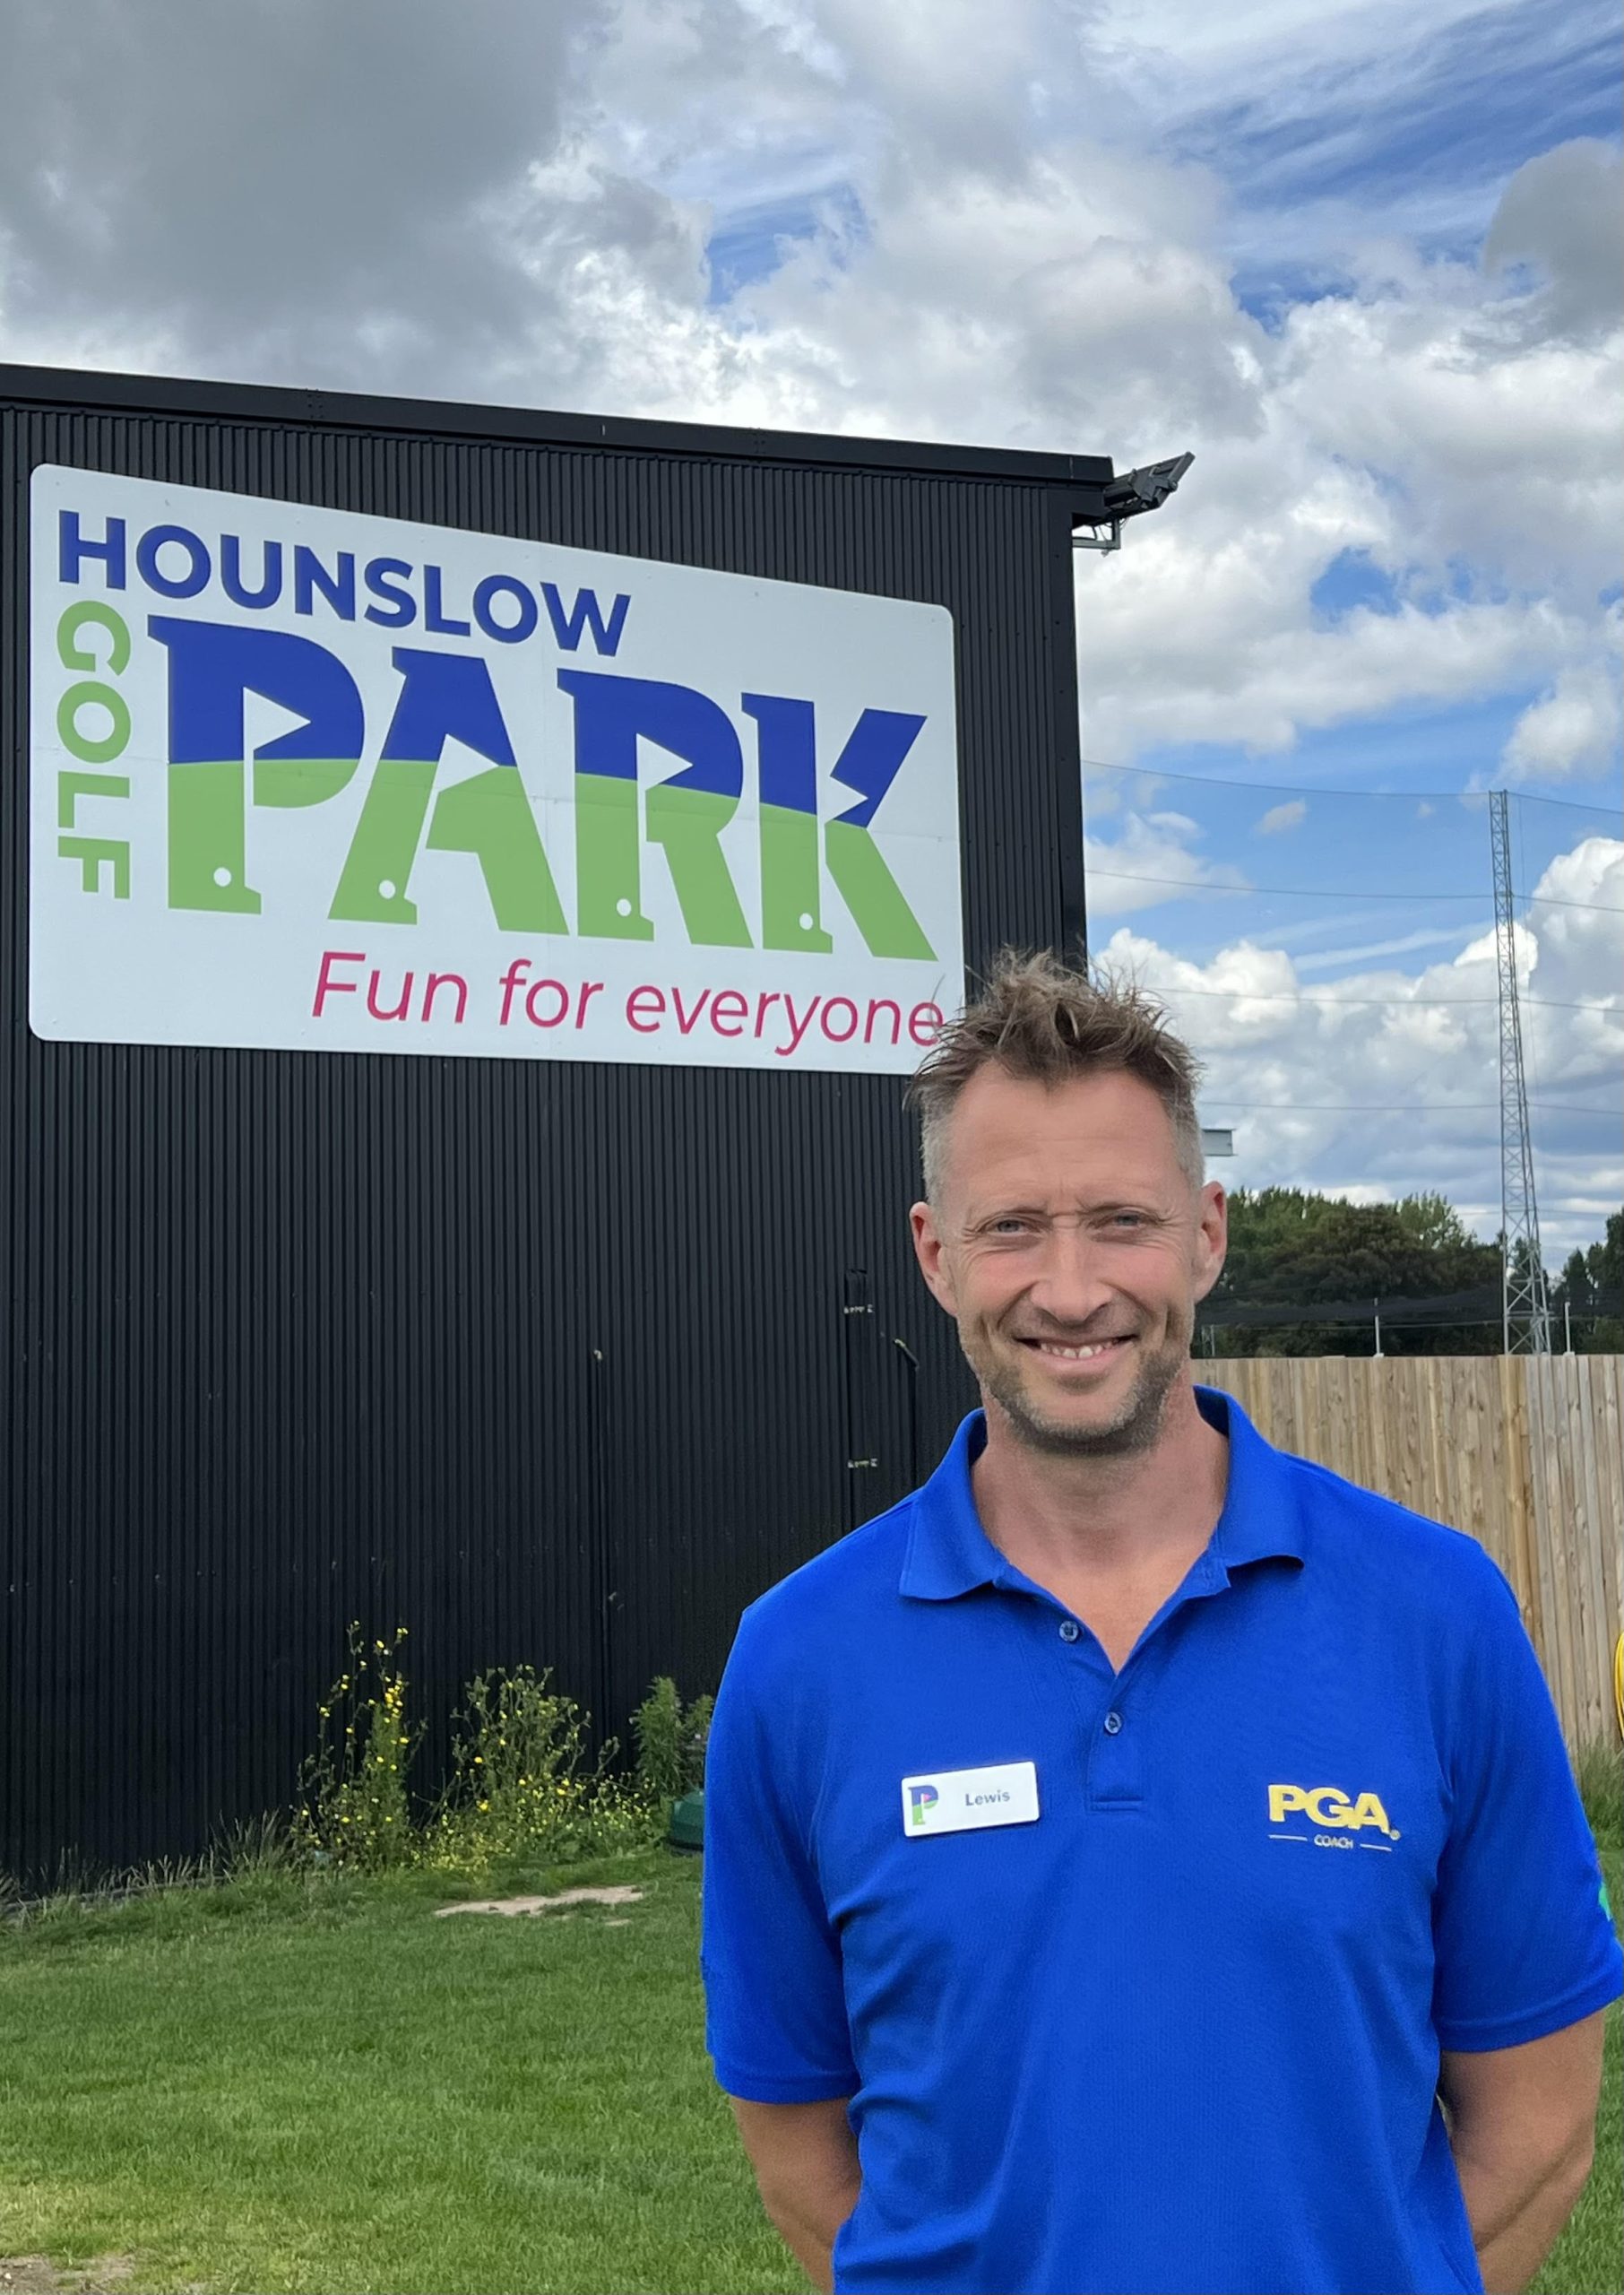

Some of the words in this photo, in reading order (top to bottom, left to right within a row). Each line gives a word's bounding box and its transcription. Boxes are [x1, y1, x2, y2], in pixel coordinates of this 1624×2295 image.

[59, 509, 632, 657] HOUNSLOW
[56, 601, 131, 899] GOLF
[146, 613, 938, 962] PARK
[311, 951, 468, 1024] Fun
[498, 958, 605, 1029] for
[624, 983, 945, 1055] everyone
[965, 1789, 1011, 1806] Lewis
[1268, 1784, 1390, 1834] PGA
[1313, 1834, 1354, 1849] COACH
